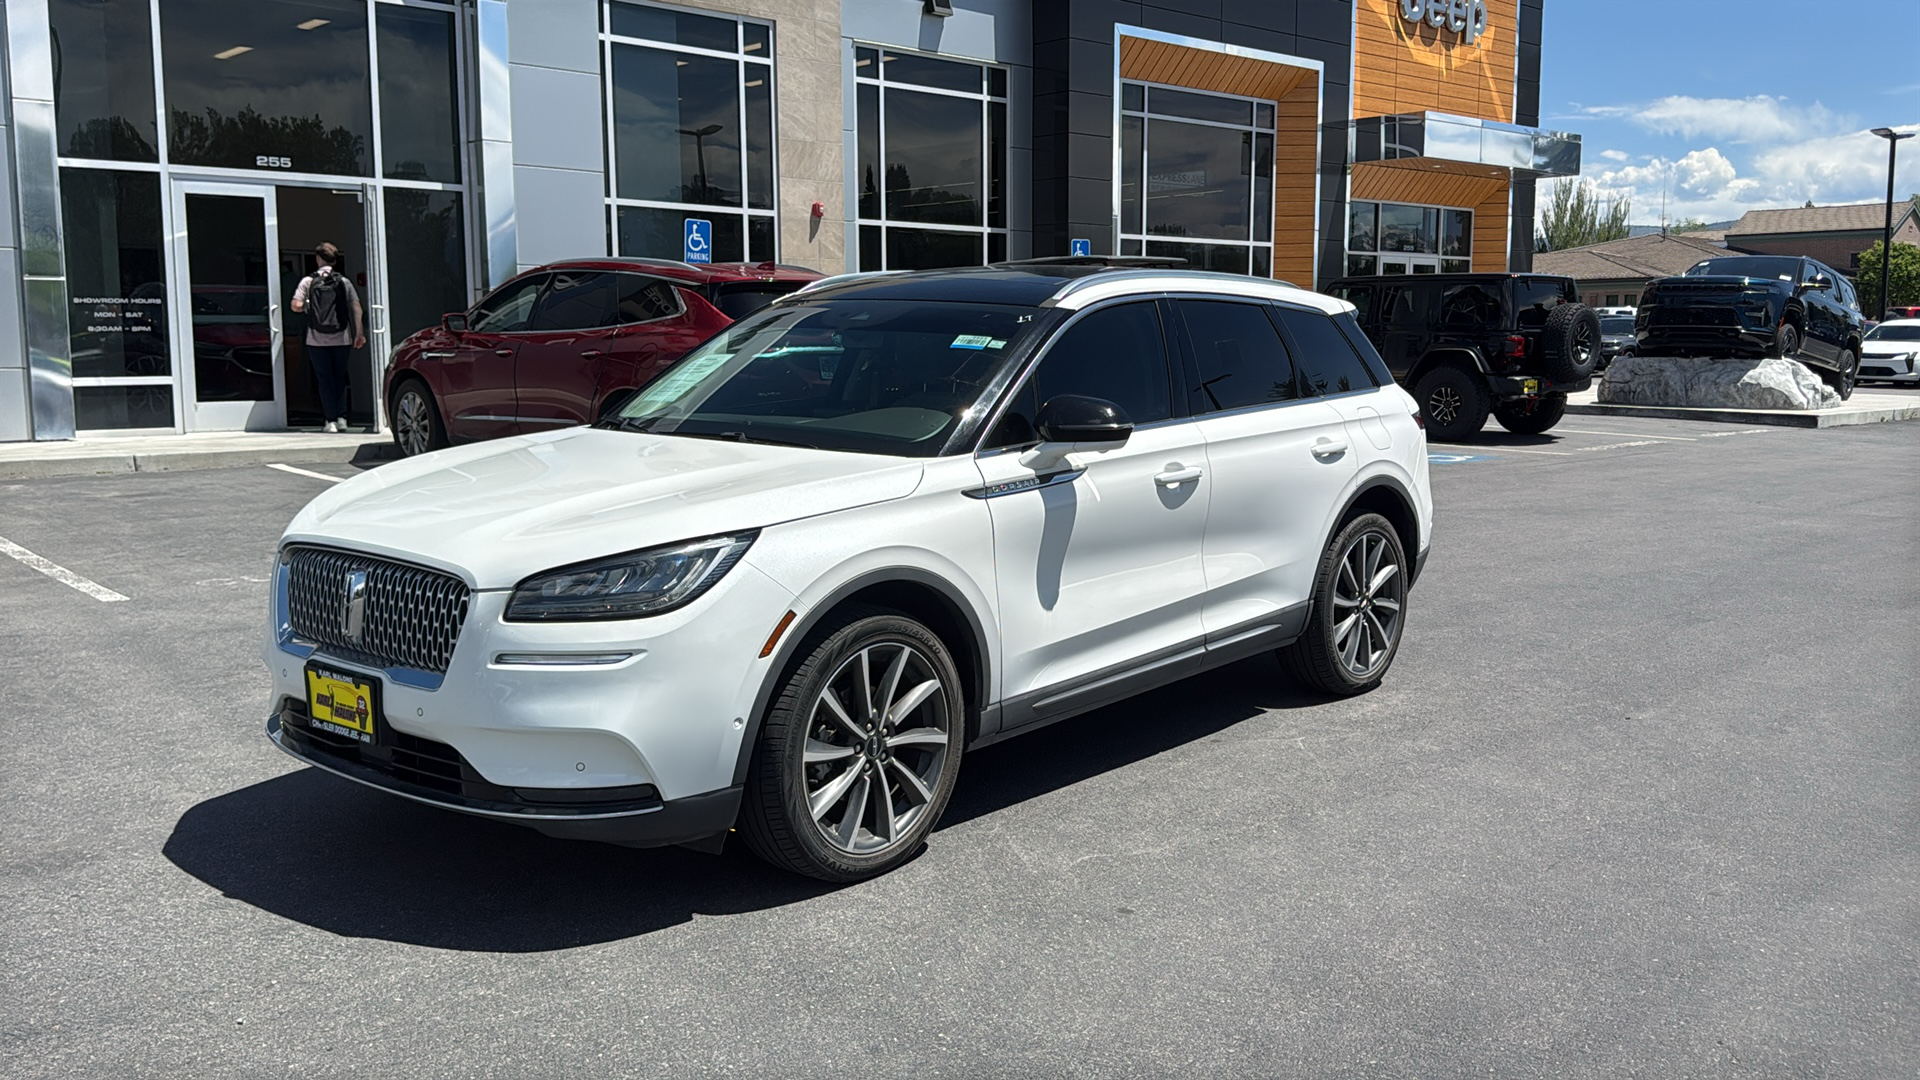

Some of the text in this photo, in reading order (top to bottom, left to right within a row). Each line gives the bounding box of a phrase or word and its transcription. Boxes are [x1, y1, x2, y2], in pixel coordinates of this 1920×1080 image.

[256, 156, 292, 168] 255
[687, 252, 709, 261] PARKING
[992, 478, 1040, 493] CORSAIR
[318, 669, 353, 684] KARL MALONE
